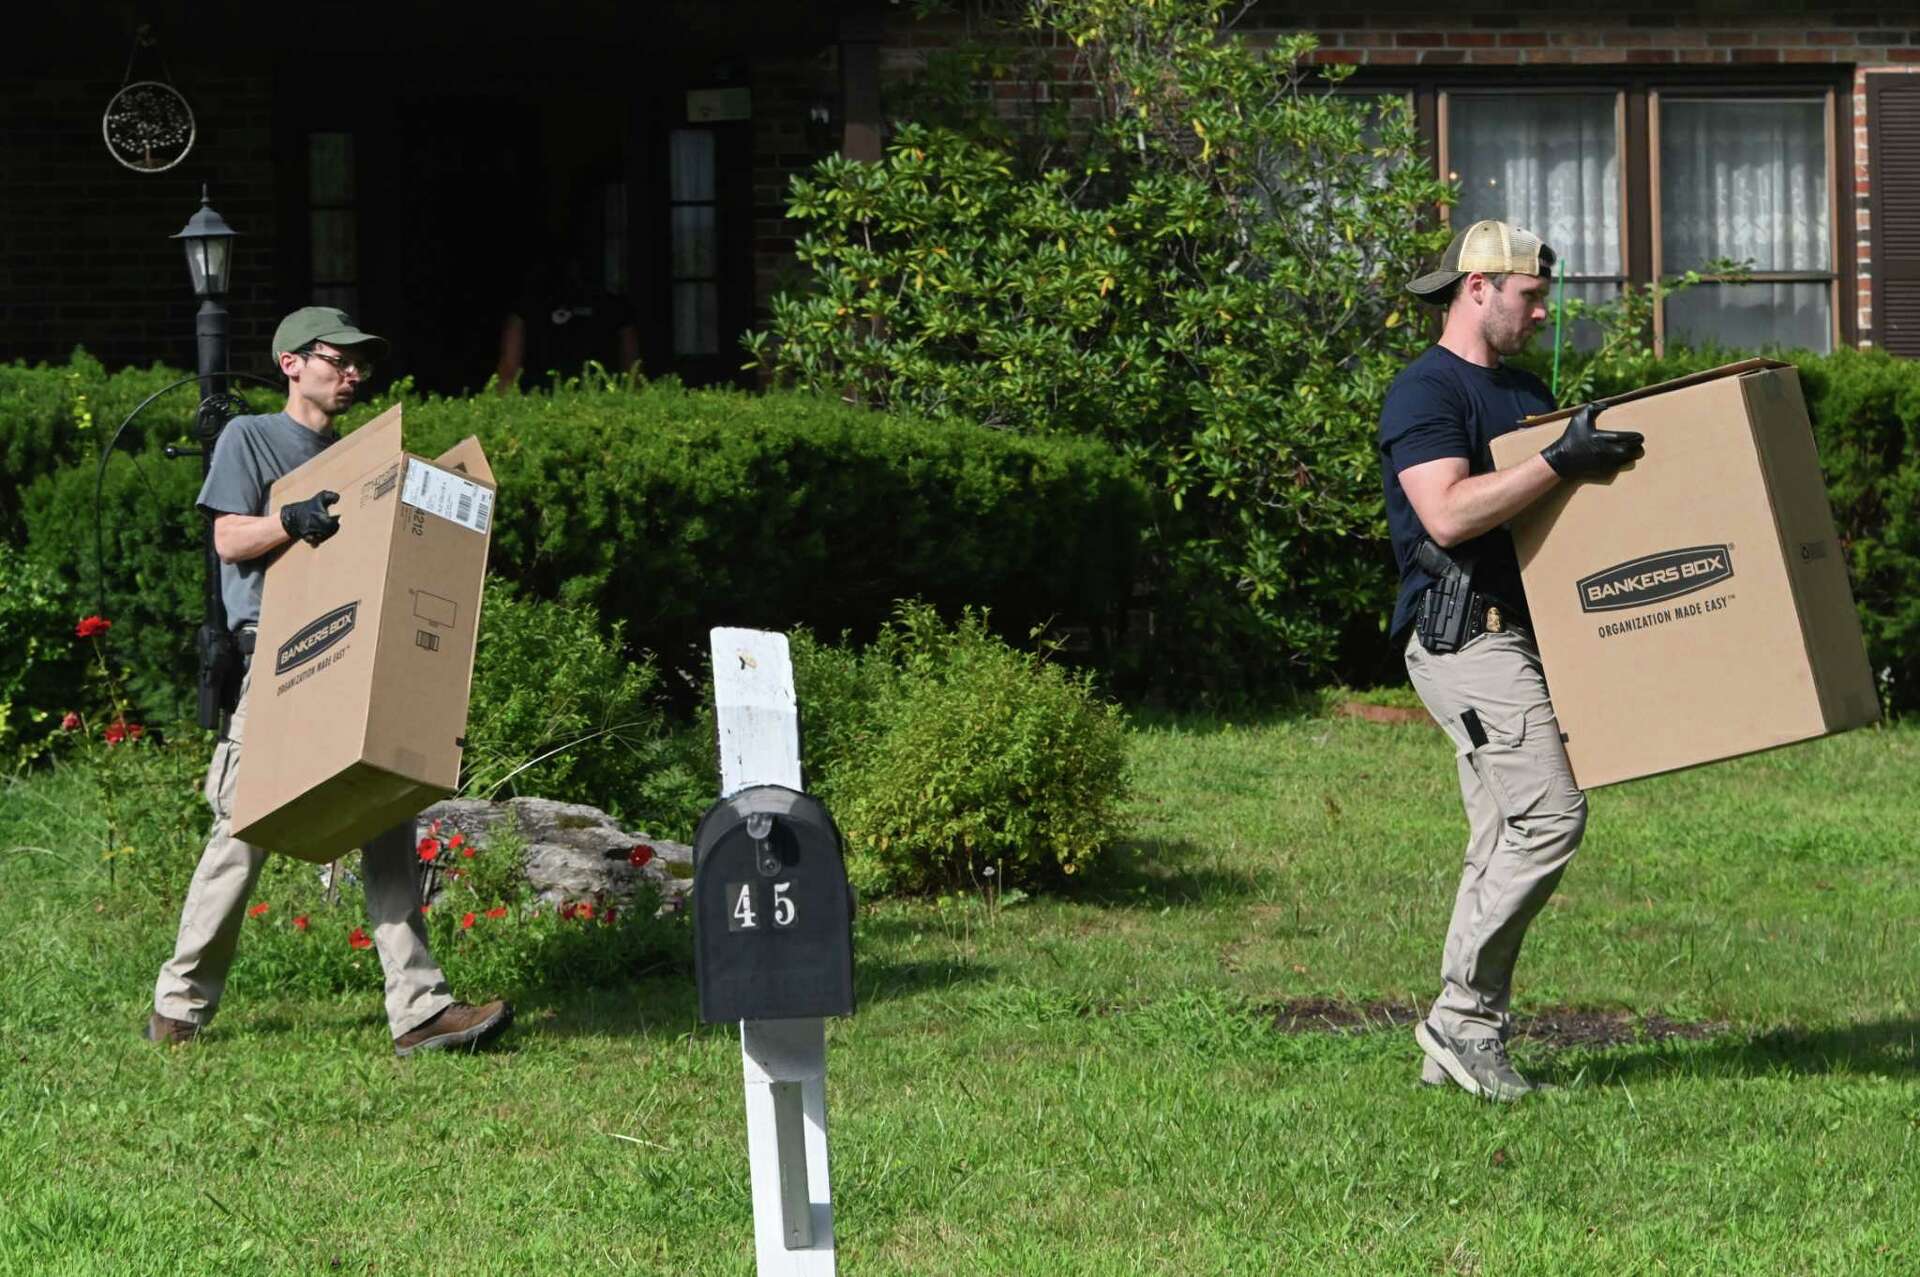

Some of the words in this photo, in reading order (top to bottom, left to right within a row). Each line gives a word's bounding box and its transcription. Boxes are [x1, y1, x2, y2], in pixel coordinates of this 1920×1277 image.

[1587, 566, 1680, 601] BANKERS
[1681, 555, 1724, 579] BOX
[280, 625, 329, 665] BANKERS
[329, 611, 353, 635] BOX
[1598, 609, 1672, 639] ORGANIZATION
[1675, 602, 1703, 620] MADE
